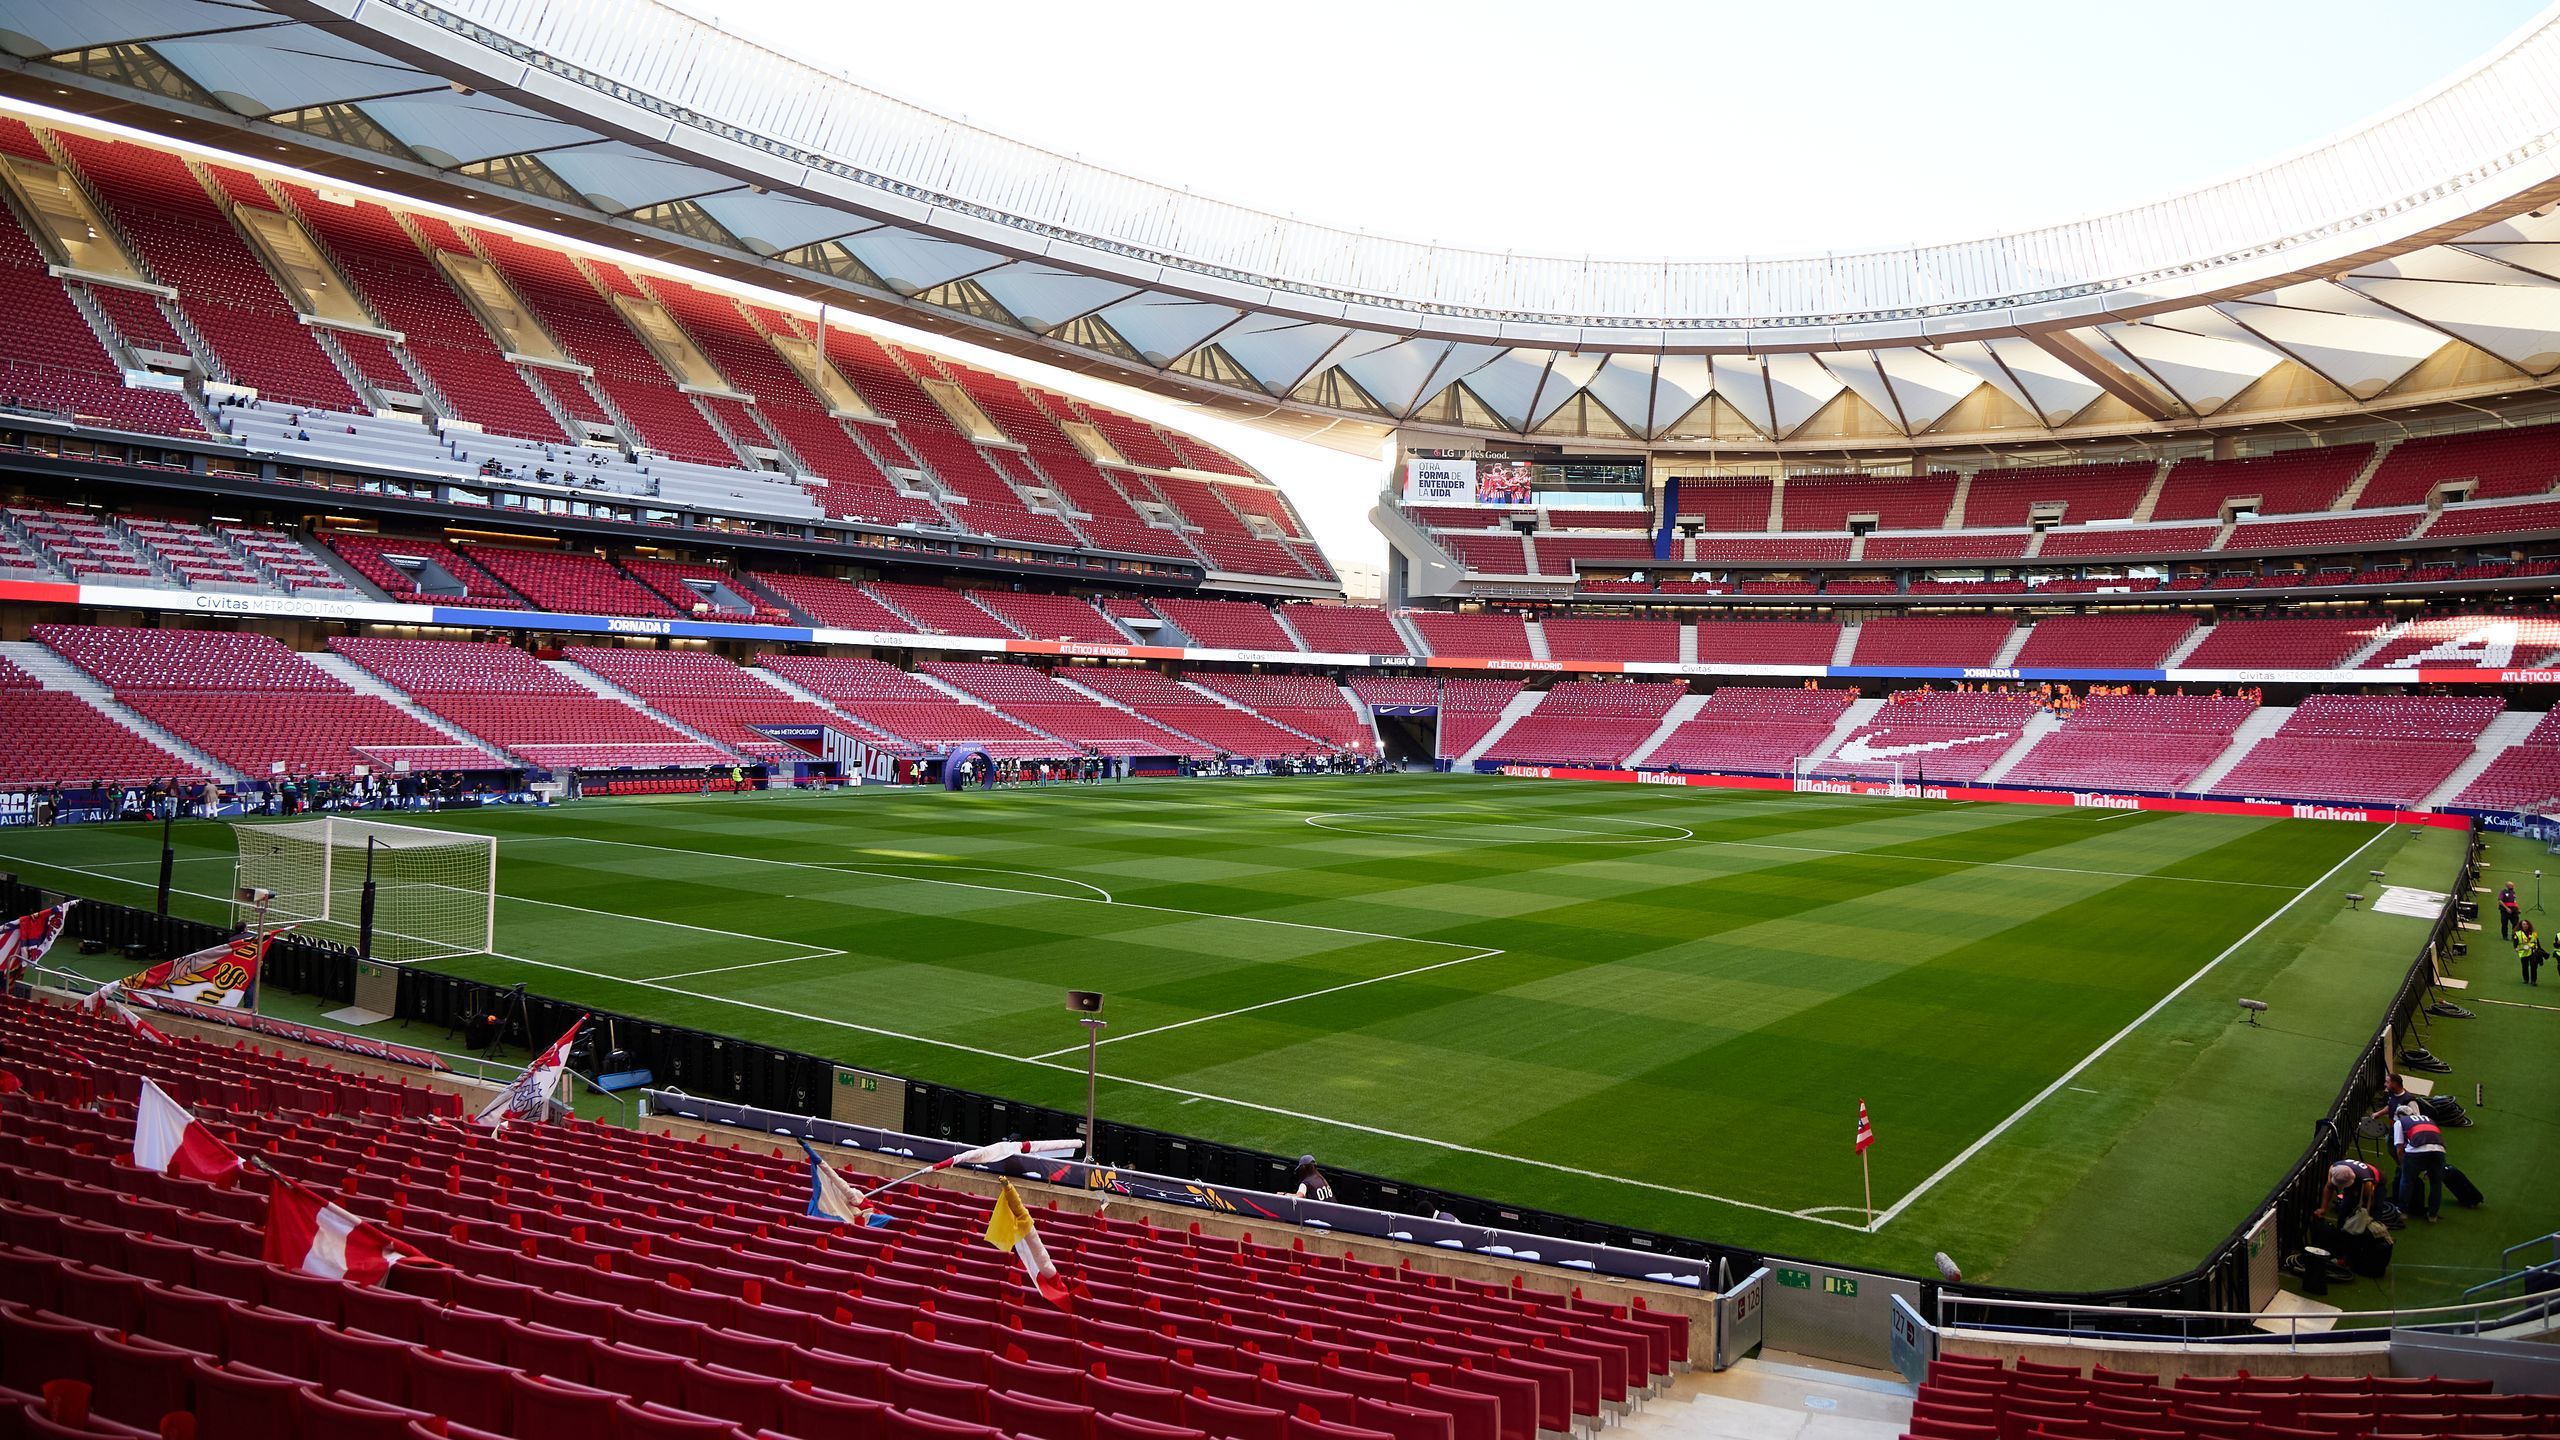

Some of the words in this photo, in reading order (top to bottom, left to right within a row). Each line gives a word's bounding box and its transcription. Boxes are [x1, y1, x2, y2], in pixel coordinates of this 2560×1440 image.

[1441, 449, 1455, 458] LG
[1418, 462, 1441, 472] OTRA
[1419, 471, 1450, 480] FORMA
[1451, 471, 1462, 481] DE
[1418, 480, 1465, 489] ENTENDER
[1418, 488, 1430, 498] LA
[1430, 488, 1451, 498] VIDA
[252, 600, 355, 615] METROPOLITANO
[607, 619, 661, 633] JORNADA
[662, 622, 671, 634] 8
[1099, 646, 1129, 656] MADRID
[1381, 656, 1407, 666] LALIGA
[1531, 661, 1563, 671] MADRID
[1963, 668, 2012, 678] JORNADA
[2012, 669, 2020, 678] 8
[2501, 669, 2552, 682] ATLÉTICO
[1505, 766, 1539, 778] LALIGA
[1637, 771, 1687, 785] Mahou
[1797, 779, 1852, 794] Mahou
[2072, 791, 2140, 810] Mahou
[2291, 804, 2368, 822] Mahou
[1316, 1185, 1333, 1201] 018
[1747, 1286, 1760, 1313] 128
[1892, 1308, 1905, 1335] 127
